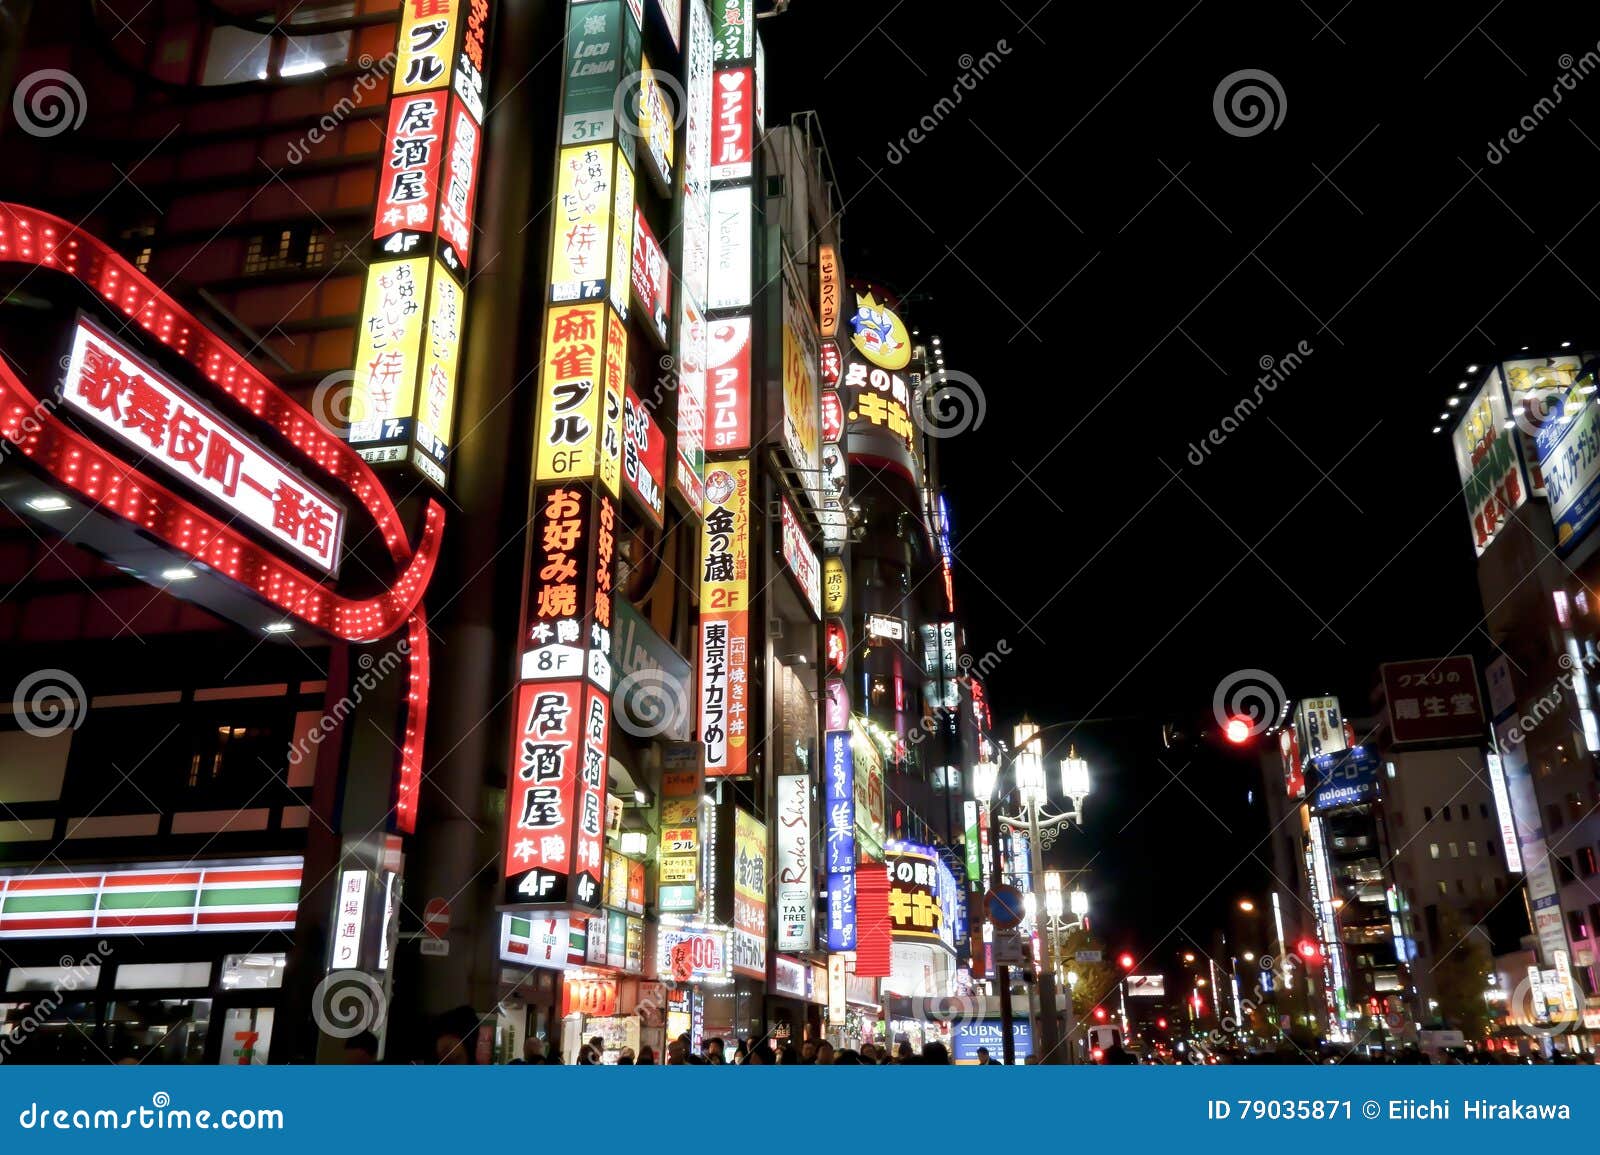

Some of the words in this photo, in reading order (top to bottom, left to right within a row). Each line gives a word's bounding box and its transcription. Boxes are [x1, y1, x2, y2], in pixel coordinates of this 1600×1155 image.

[572, 120, 604, 140] 3F
[720, 91, 744, 162] アイフル
[392, 101, 437, 201] 居酒屋
[585, 151, 607, 192] お好み
[384, 232, 420, 252] 4F
[396, 265, 418, 315] お好み
[583, 281, 601, 297] 7F
[550, 309, 596, 445] 麻雀ブル
[715, 367, 738, 428] アコム
[78, 340, 333, 558] 歌舞伎町一番街
[384, 420, 404, 438] 7F
[715, 431, 737, 445] 3F
[552, 450, 583, 473] 6F
[538, 489, 582, 617] お好み焼
[704, 505, 735, 582] 金の蔵
[710, 588, 739, 608] 2F
[537, 651, 569, 670] 8F
[705, 624, 727, 764] 東京チカラめし
[729, 669, 746, 735] 焼き牛丼
[519, 692, 572, 829] 居酒屋
[582, 696, 604, 836] 居酒屋
[518, 870, 555, 896] 4F
[342, 879, 361, 960] 劇場通り
[783, 905, 806, 913] TAX
[783, 914, 806, 922] FREE
[960, 1024, 1029, 1037] SUBNDE
